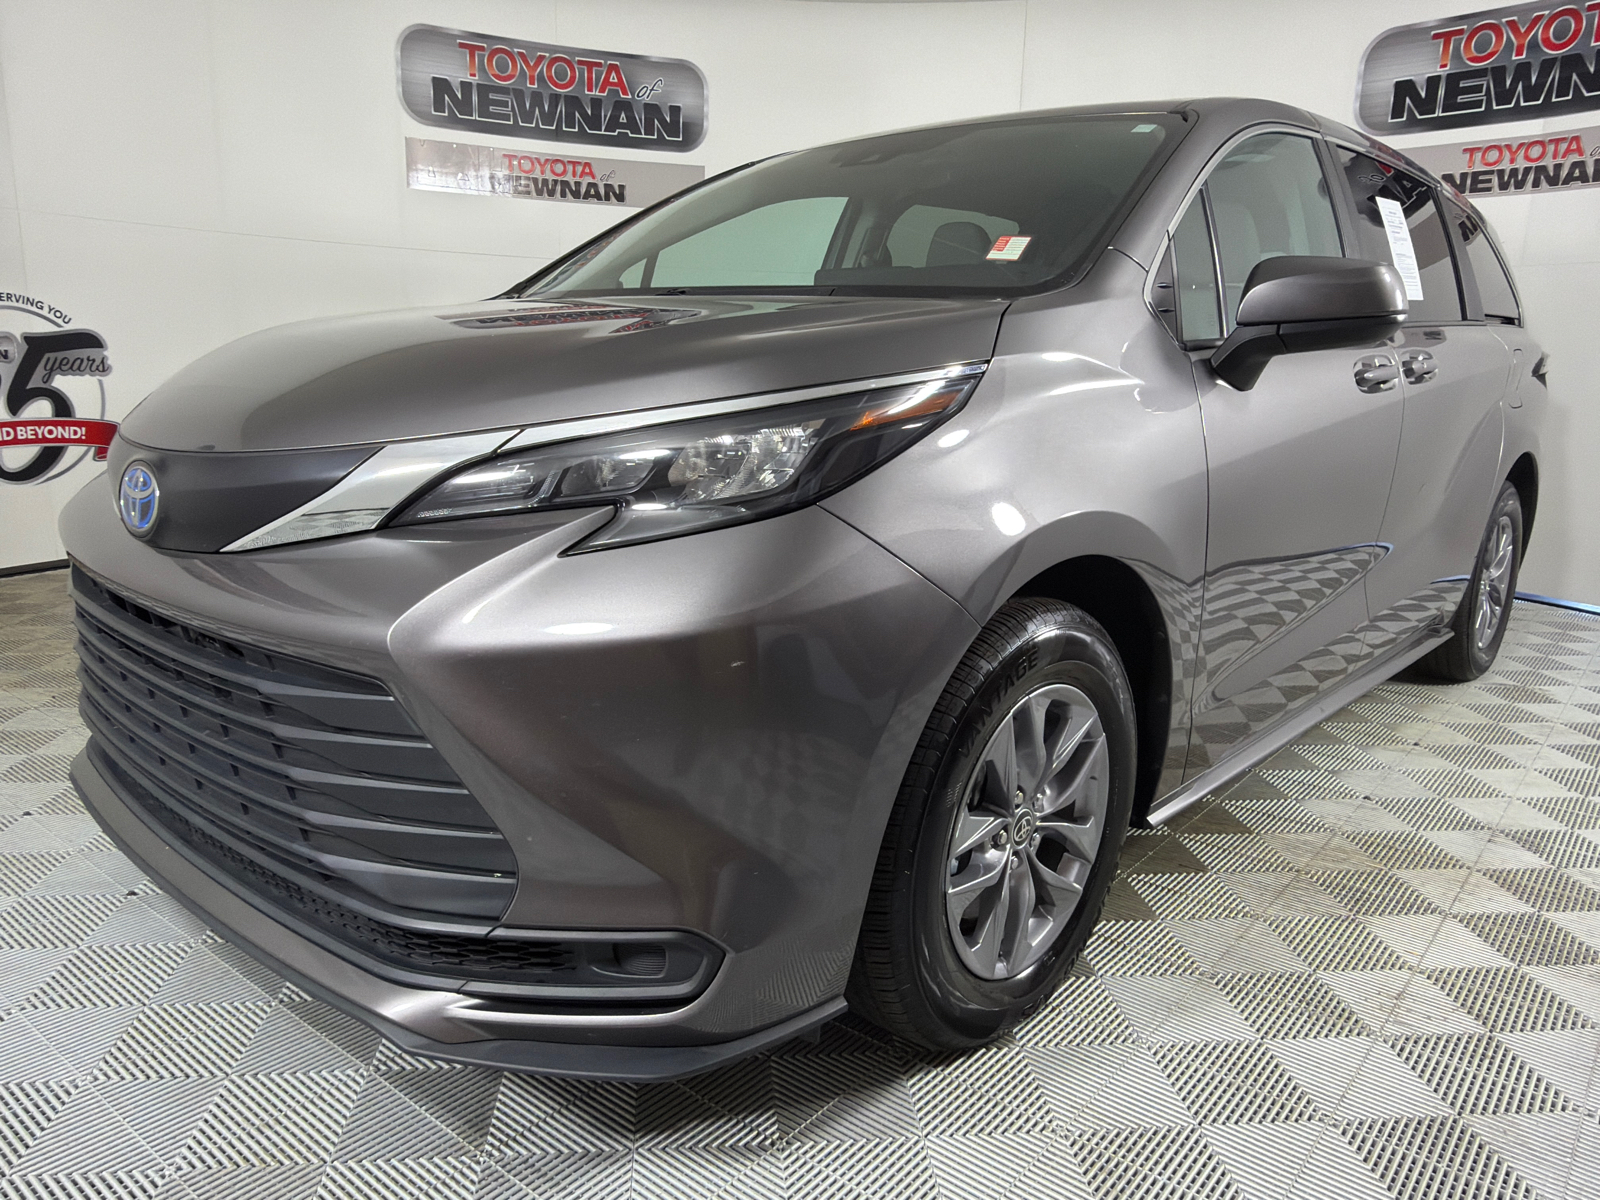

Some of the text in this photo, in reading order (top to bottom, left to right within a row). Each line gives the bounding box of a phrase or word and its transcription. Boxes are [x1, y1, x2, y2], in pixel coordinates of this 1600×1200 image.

[457, 39, 631, 99] TOYOTA
[635, 77, 663, 101] of
[430, 75, 683, 141] NEWNAN
[1462, 135, 1585, 169] TOYOTA
[502, 153, 596, 180] TOYOTA
[600, 169, 616, 182] of
[47, 304, 72, 325] YOU
[42, 355, 109, 384] years
[16, 425, 87, 440] BEYOND!
